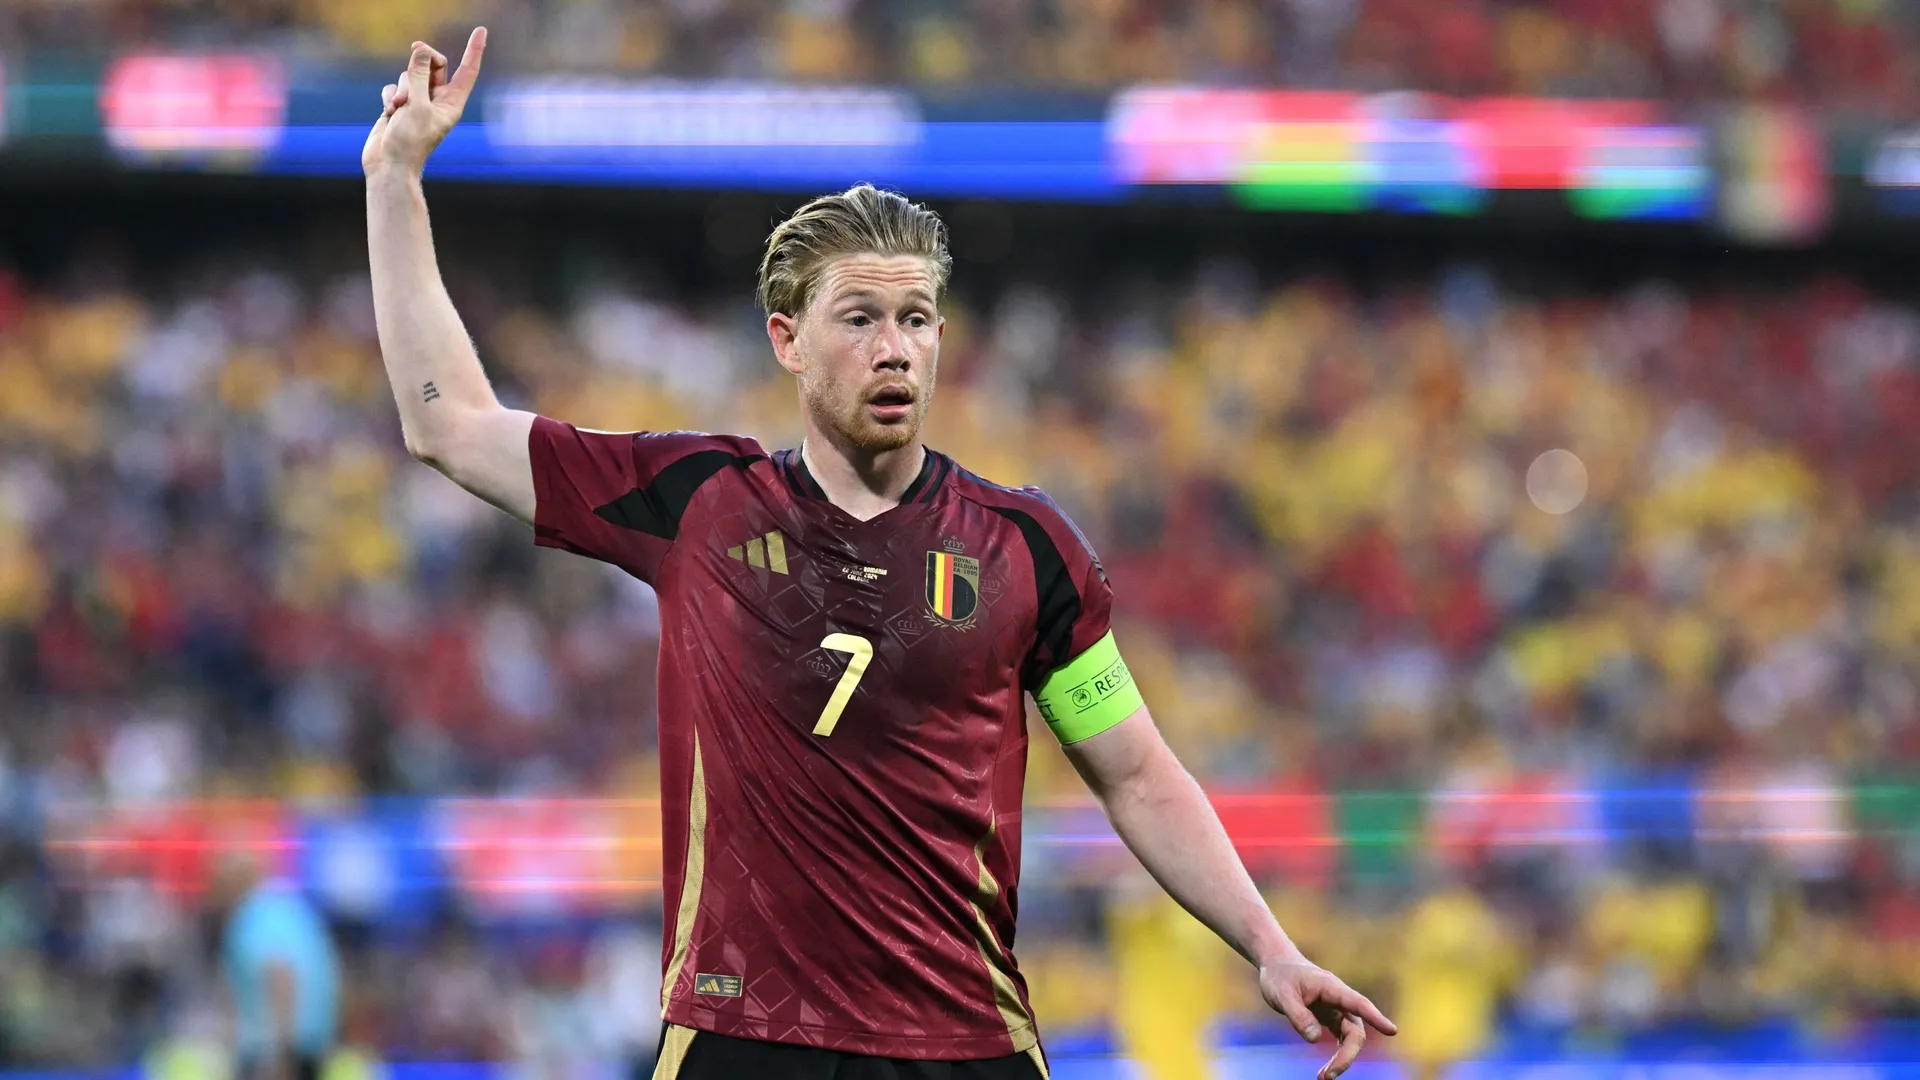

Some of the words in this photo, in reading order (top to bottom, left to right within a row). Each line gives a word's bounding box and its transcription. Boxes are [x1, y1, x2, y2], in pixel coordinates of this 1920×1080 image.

[953, 556, 972, 565] ROYAL
[953, 562, 978, 571] BELGIAN
[812, 632, 874, 738] 7
